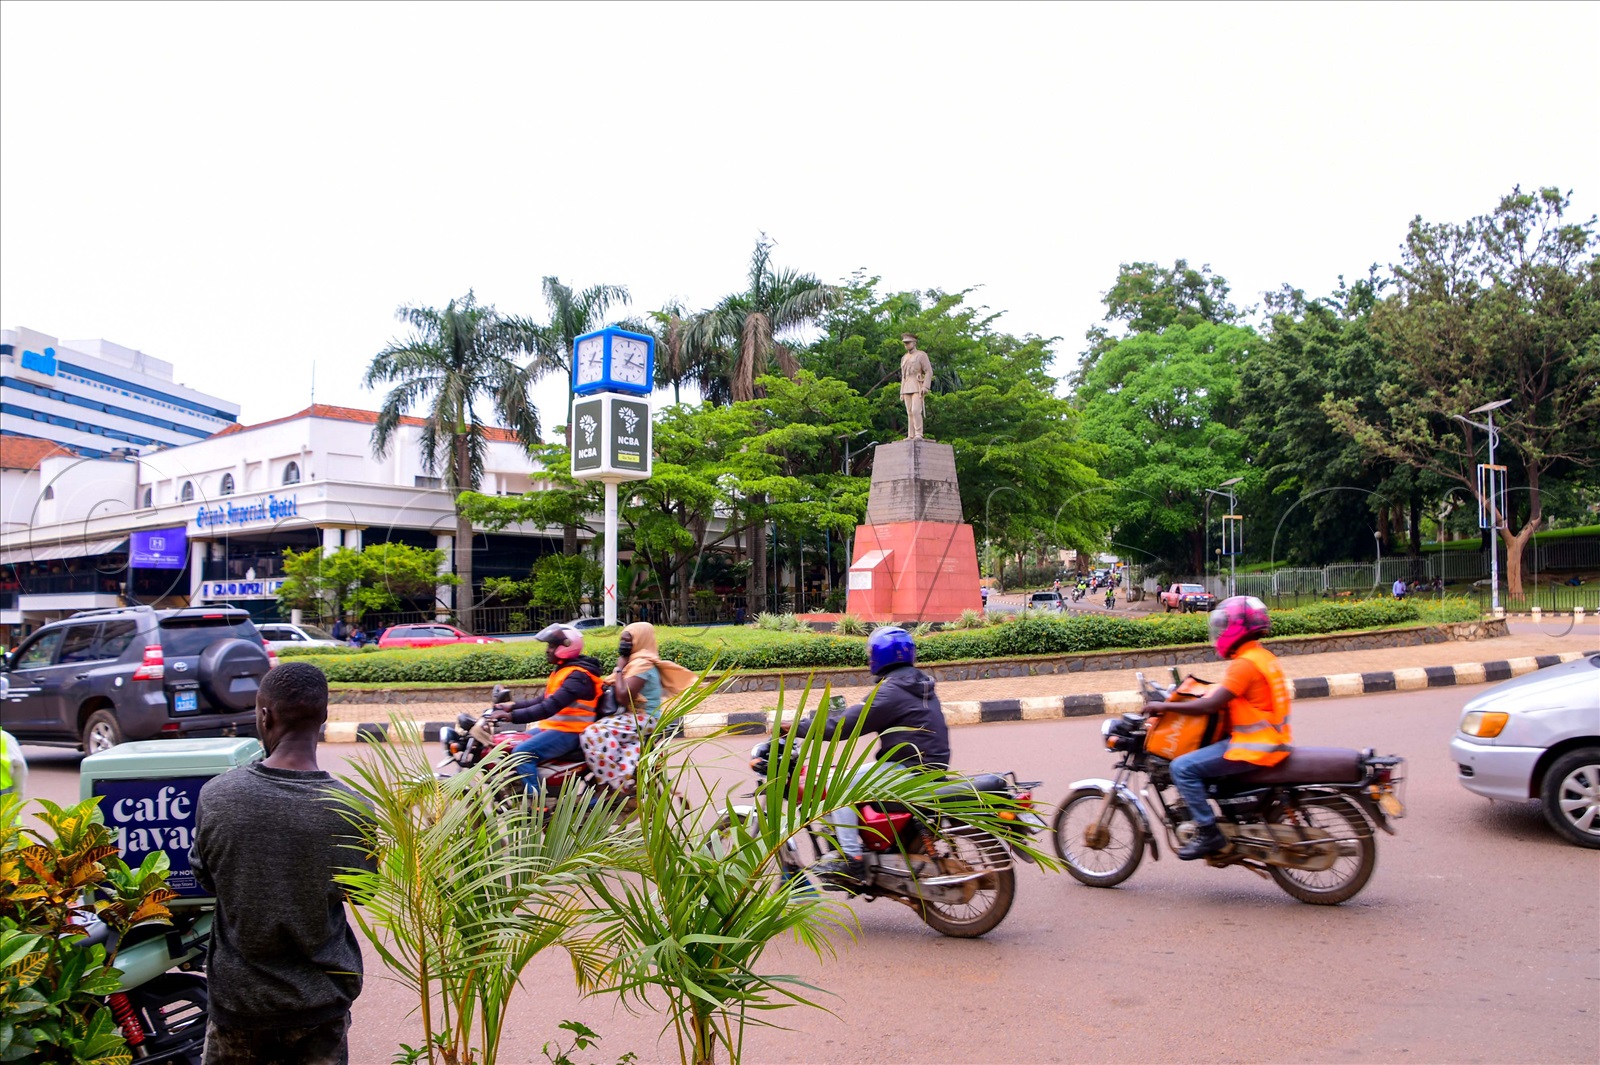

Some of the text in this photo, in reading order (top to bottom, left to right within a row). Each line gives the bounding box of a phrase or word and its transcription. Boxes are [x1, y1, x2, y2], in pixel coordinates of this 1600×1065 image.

[618, 436, 640, 446] NCBA
[578, 447, 597, 459] NCBA
[196, 493, 297, 528] Grand Imperial Hotel
[112, 786, 191, 823] café
